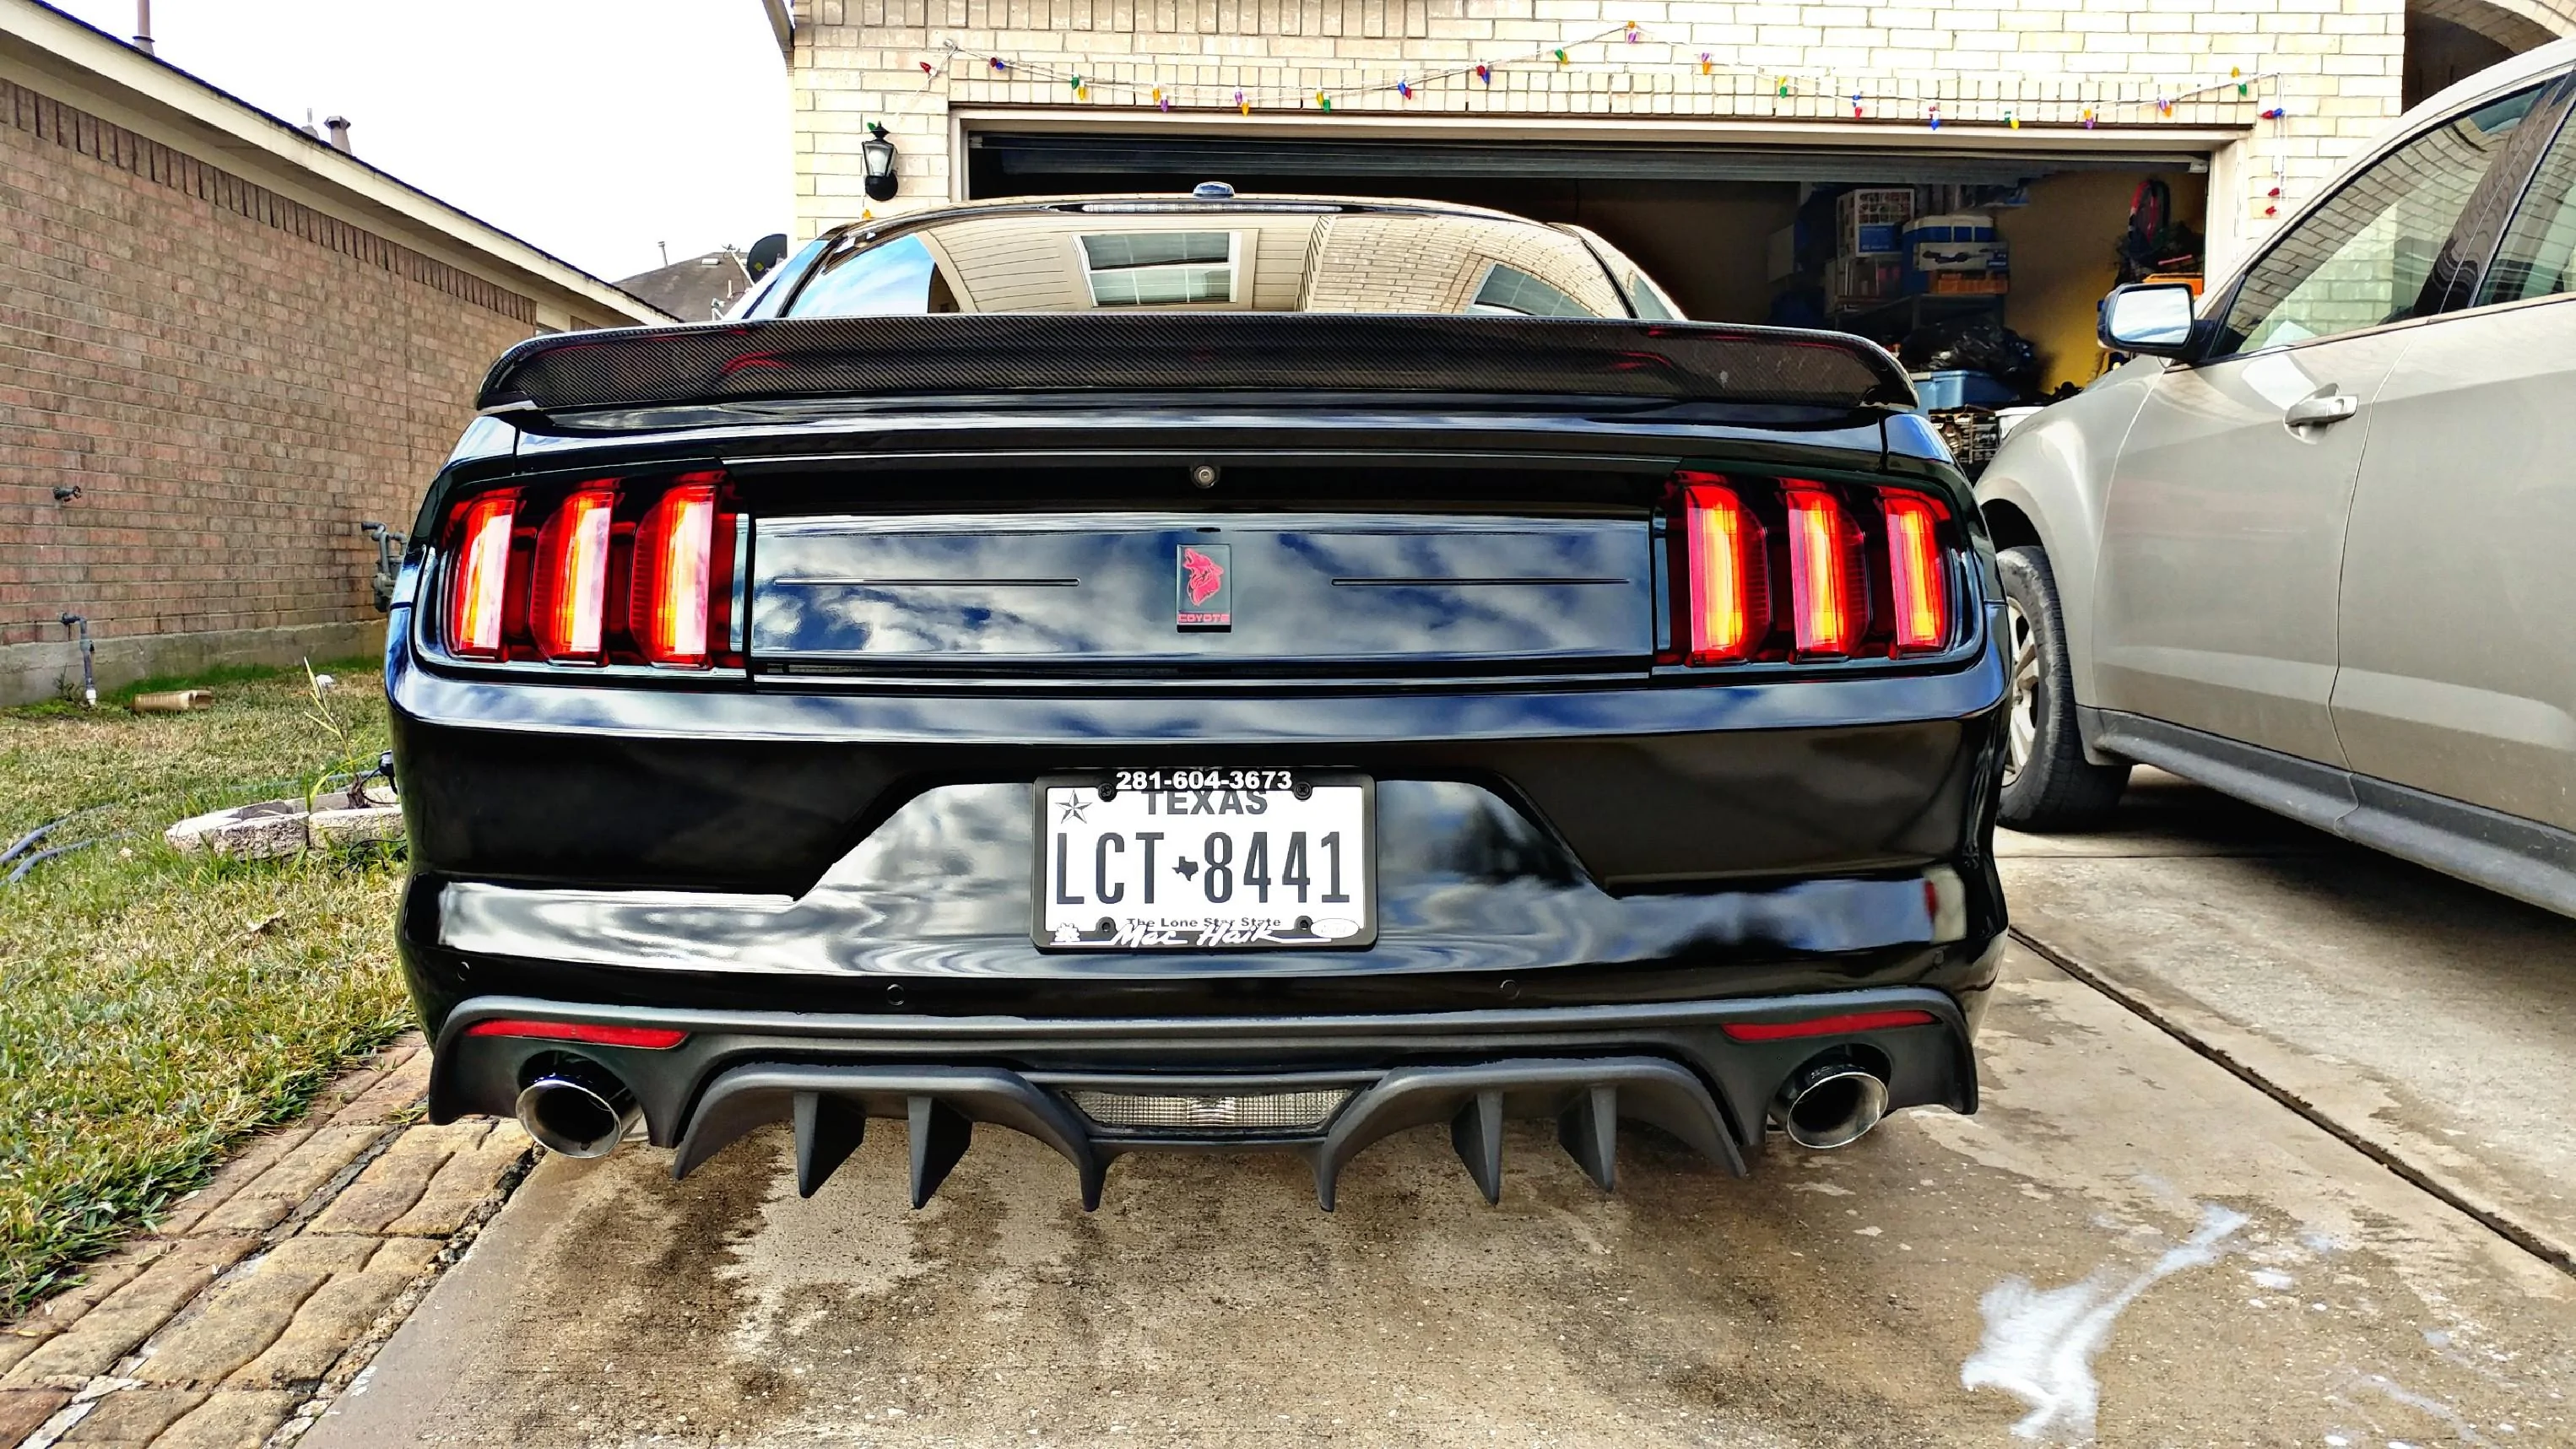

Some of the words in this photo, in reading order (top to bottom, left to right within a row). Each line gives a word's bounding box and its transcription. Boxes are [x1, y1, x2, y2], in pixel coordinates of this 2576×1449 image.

[1178, 613, 1230, 623] COYOTE
[1116, 770, 1292, 791] 281-604-3673
[1142, 790, 1268, 815] TEXAS
[1057, 831, 1164, 904] LCT
[1204, 831, 1350, 904] 8441
[1127, 918, 1155, 927] The
[1161, 917, 1198, 927] Lone
[1204, 917, 1235, 927] Star
[1241, 917, 1280, 927] State
[1112, 923, 1188, 947] Mac
[1197, 923, 1274, 946] Haik
